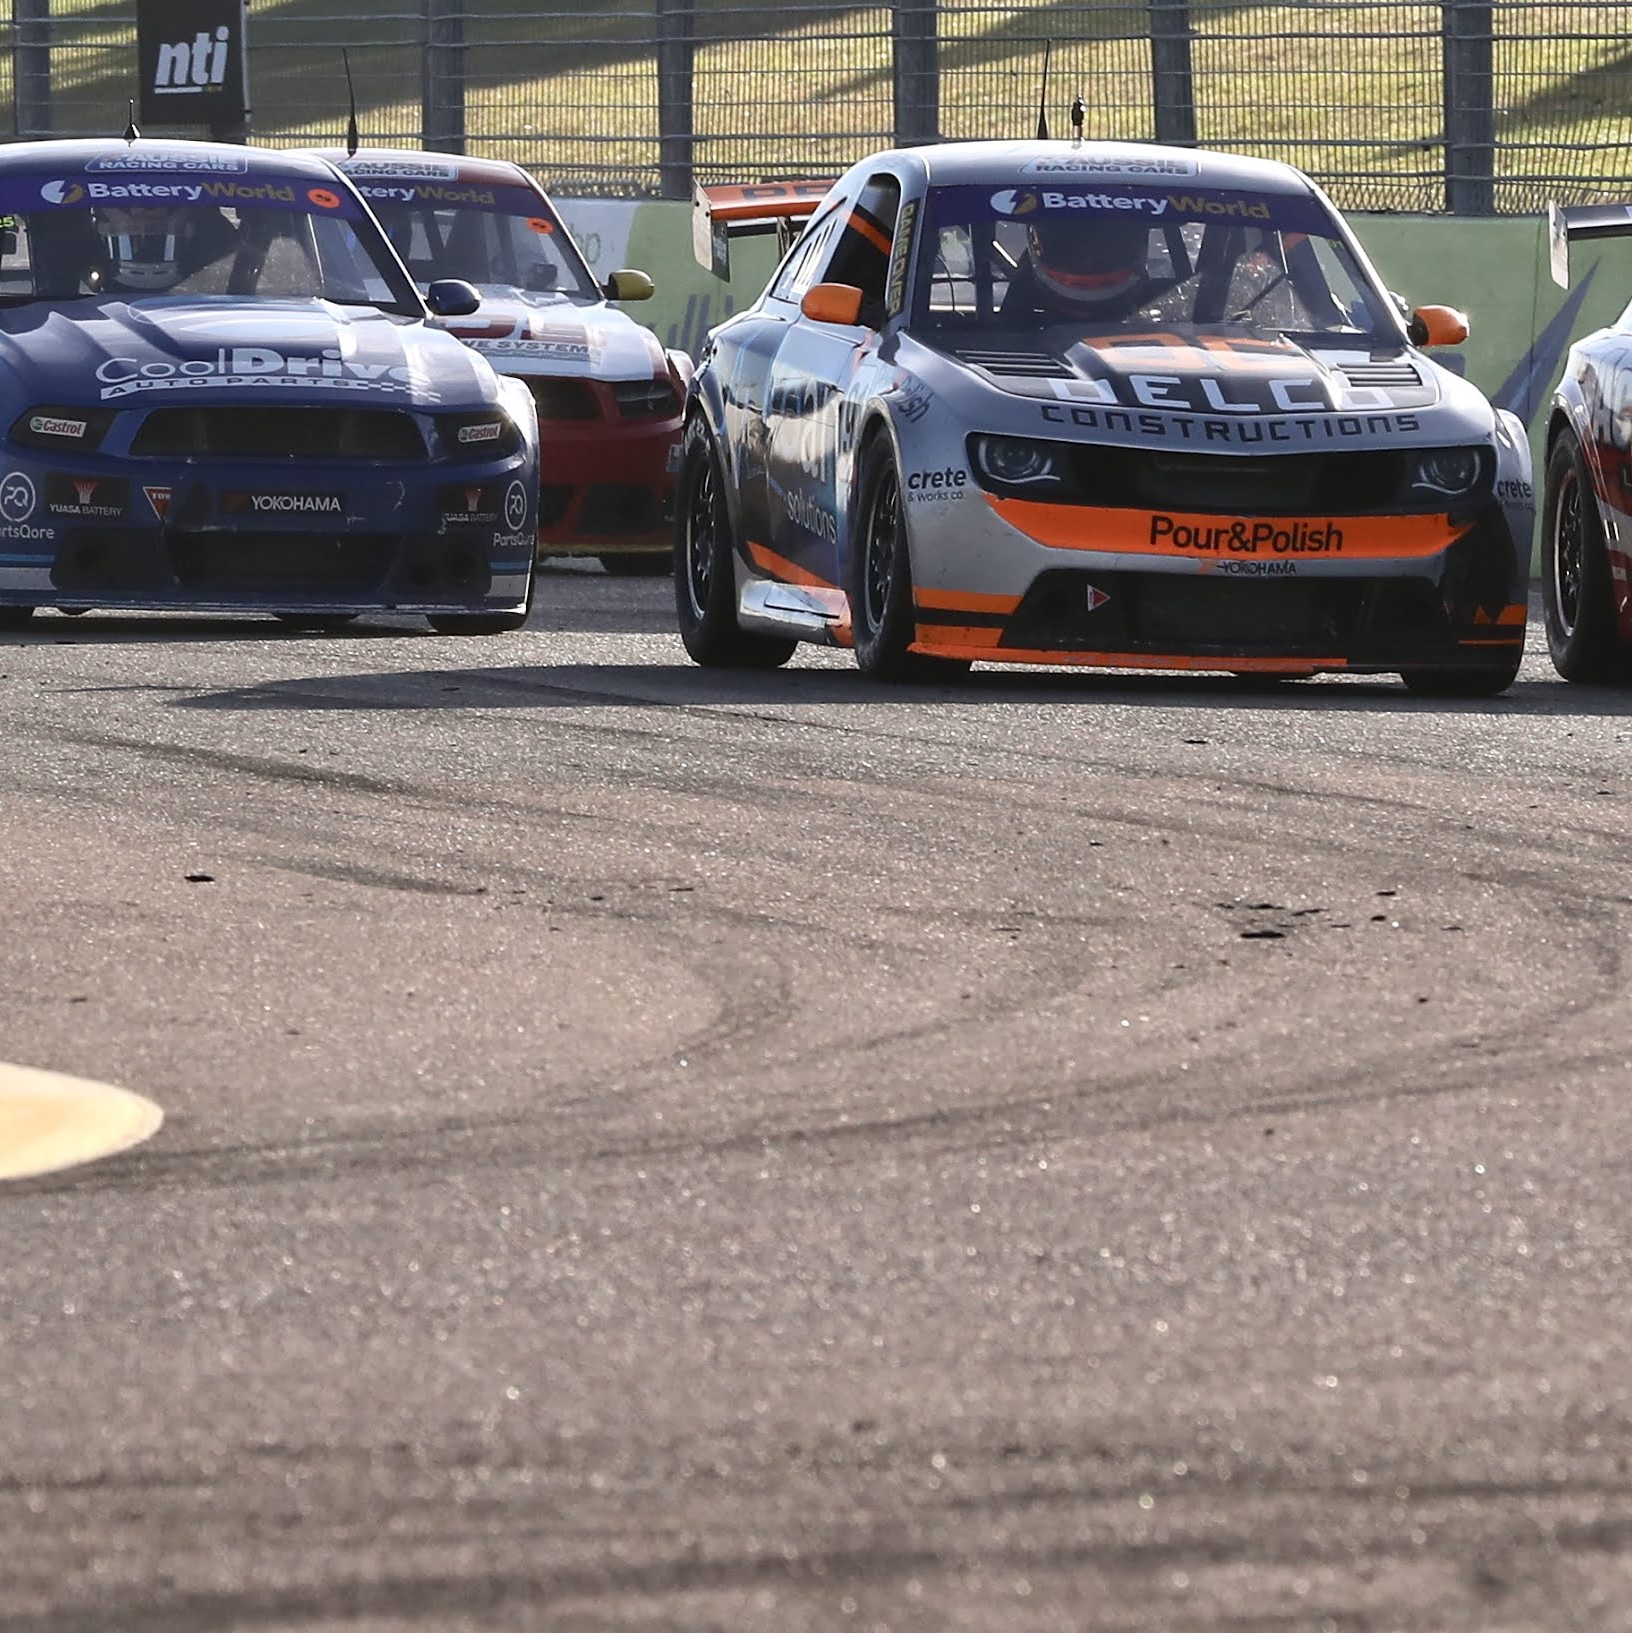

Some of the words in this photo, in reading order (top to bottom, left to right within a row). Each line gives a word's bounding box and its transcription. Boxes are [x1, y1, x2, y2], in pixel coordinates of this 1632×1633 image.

[154, 25, 229, 86] nti
[99, 161, 174, 170] RACING
[178, 161, 238, 171] CARS
[345, 168, 400, 177] ACING
[403, 168, 449, 177] CARS
[1035, 163, 1121, 173] RACING
[1128, 165, 1189, 175] CARS
[88, 182, 296, 202] BatteryWorld
[359, 185, 495, 205] teryWorld
[1043, 192, 1271, 219] BatteryWorld
[896, 202, 915, 257] GAME
[888, 258, 908, 319] OVER
[498, 341, 591, 355] SYSTEM
[107, 379, 207, 398] AUTO
[44, 419, 82, 436] Castrol
[467, 426, 498, 441] Castrol
[1041, 404, 1421, 443] CONSTRUCTIONS
[908, 468, 967, 490] crete
[1497, 478, 1531, 498] crete
[50, 503, 81, 514] YUASA
[82, 506, 123, 517] BATTERY
[251, 495, 342, 511] YOKOHAMA
[786, 489, 837, 545] solutions
[1149, 515, 1343, 553] Pour&Polish
[1222, 559, 1297, 575] YOKOHAMA
